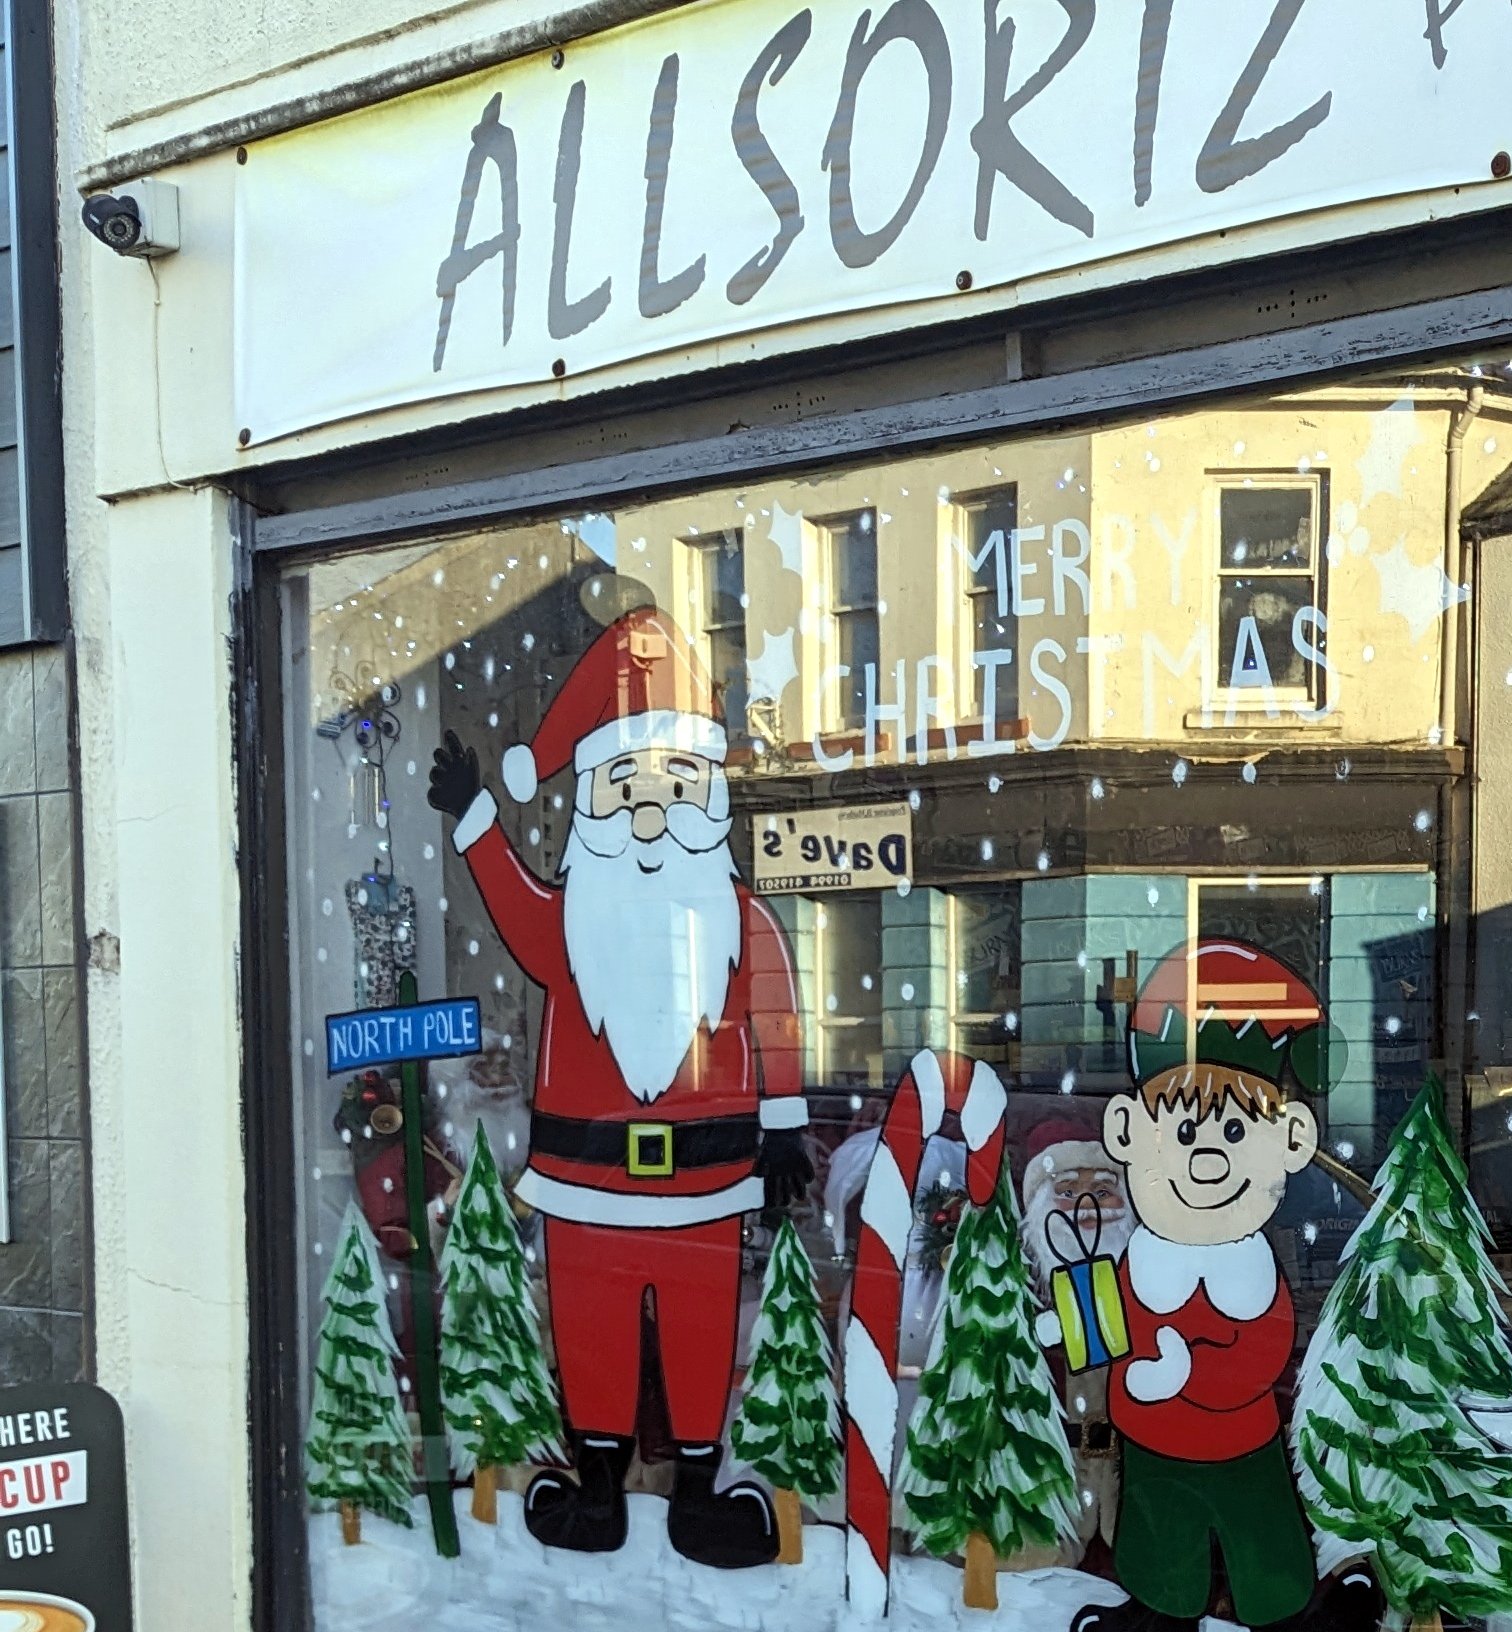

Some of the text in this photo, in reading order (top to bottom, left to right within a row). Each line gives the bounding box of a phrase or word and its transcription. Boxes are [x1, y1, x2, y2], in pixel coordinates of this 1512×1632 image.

[952, 509, 1196, 618] MERRY
[811, 606, 1343, 772] CHRISTMAS
[332, 1007, 476, 1064] NORTH POLE
[0, 1460, 70, 1508] CUP
[7, 1523, 54, 1559] GO!
